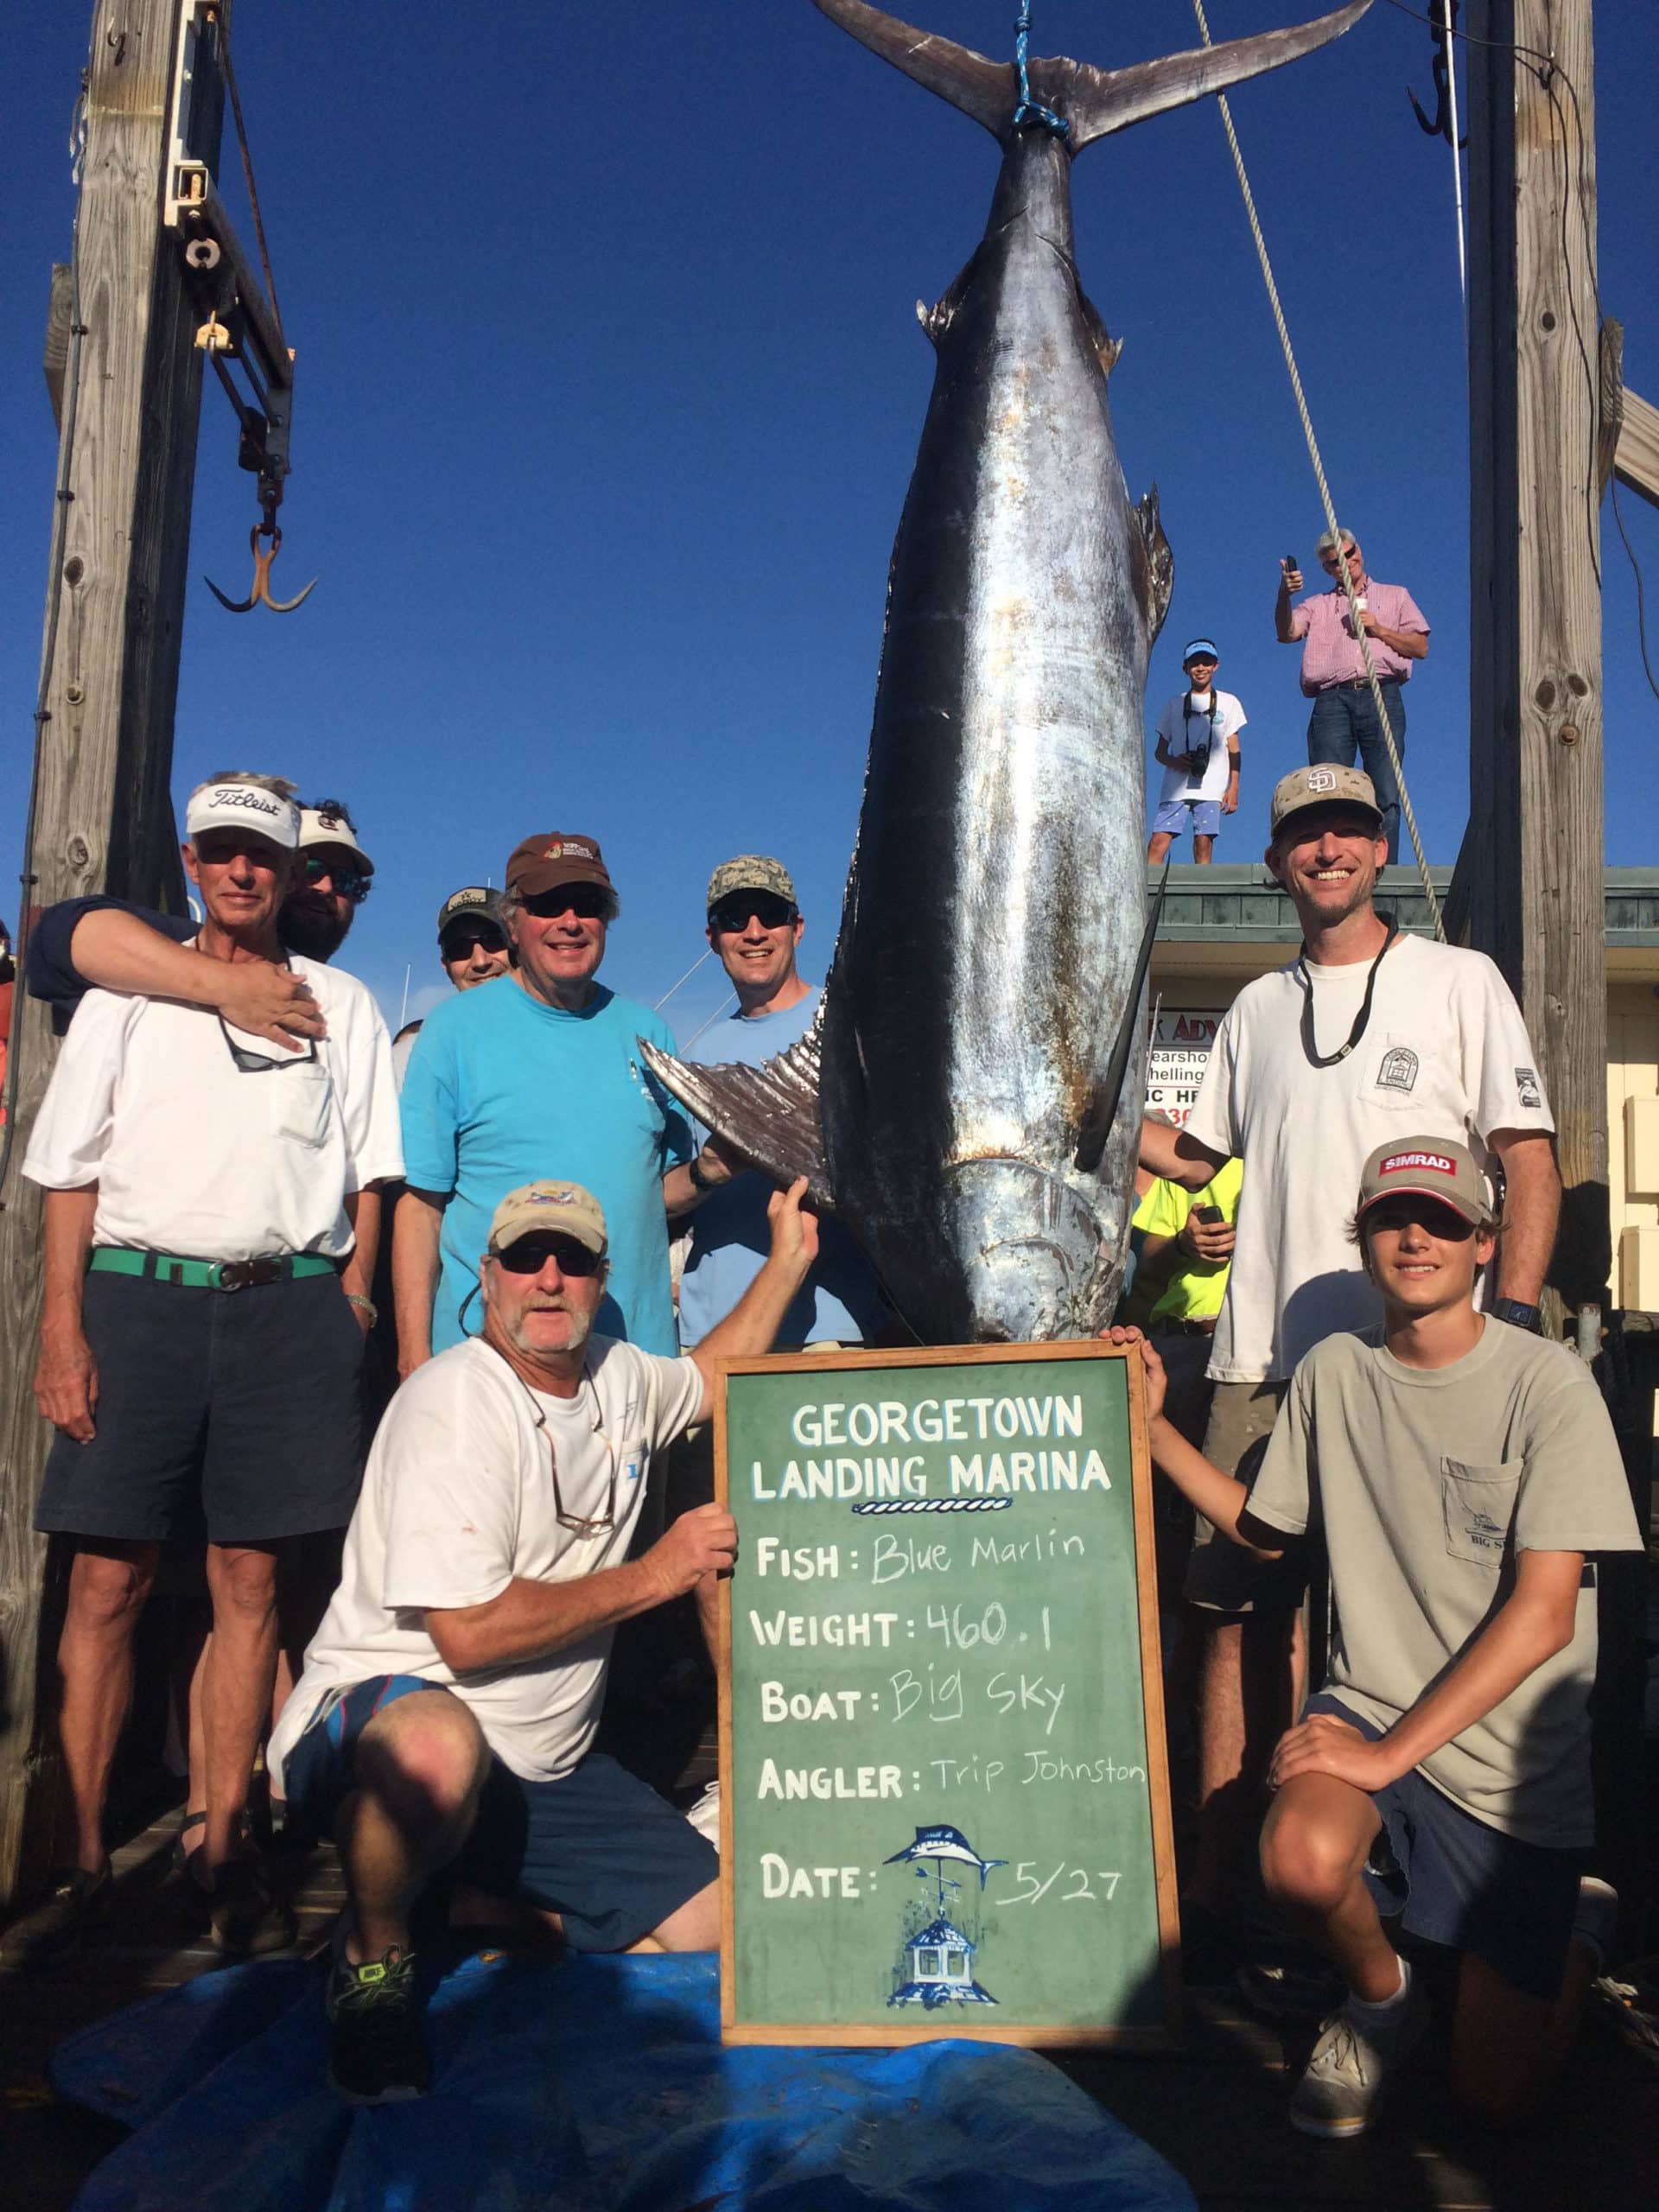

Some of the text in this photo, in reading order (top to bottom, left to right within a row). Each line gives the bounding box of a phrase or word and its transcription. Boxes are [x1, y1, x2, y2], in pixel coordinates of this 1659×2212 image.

[208, 789, 281, 816] Titleist
[1153, 1051, 1211, 1063] earsho
[1385, 1154, 1451, 1170] SIMRAD
[793, 1395, 1083, 1446] GEORGETOWN
[753, 1450, 1111, 1499] LANDING MARINA
[871, 1534, 950, 1584] Blue
[970, 1529, 1085, 1566] Marlin
[889, 1662, 963, 1722] Big
[930, 1755, 1004, 1792] Trip
[1021, 1751, 1146, 1784] Johnston
[995, 1861, 1122, 1905] 5/27
